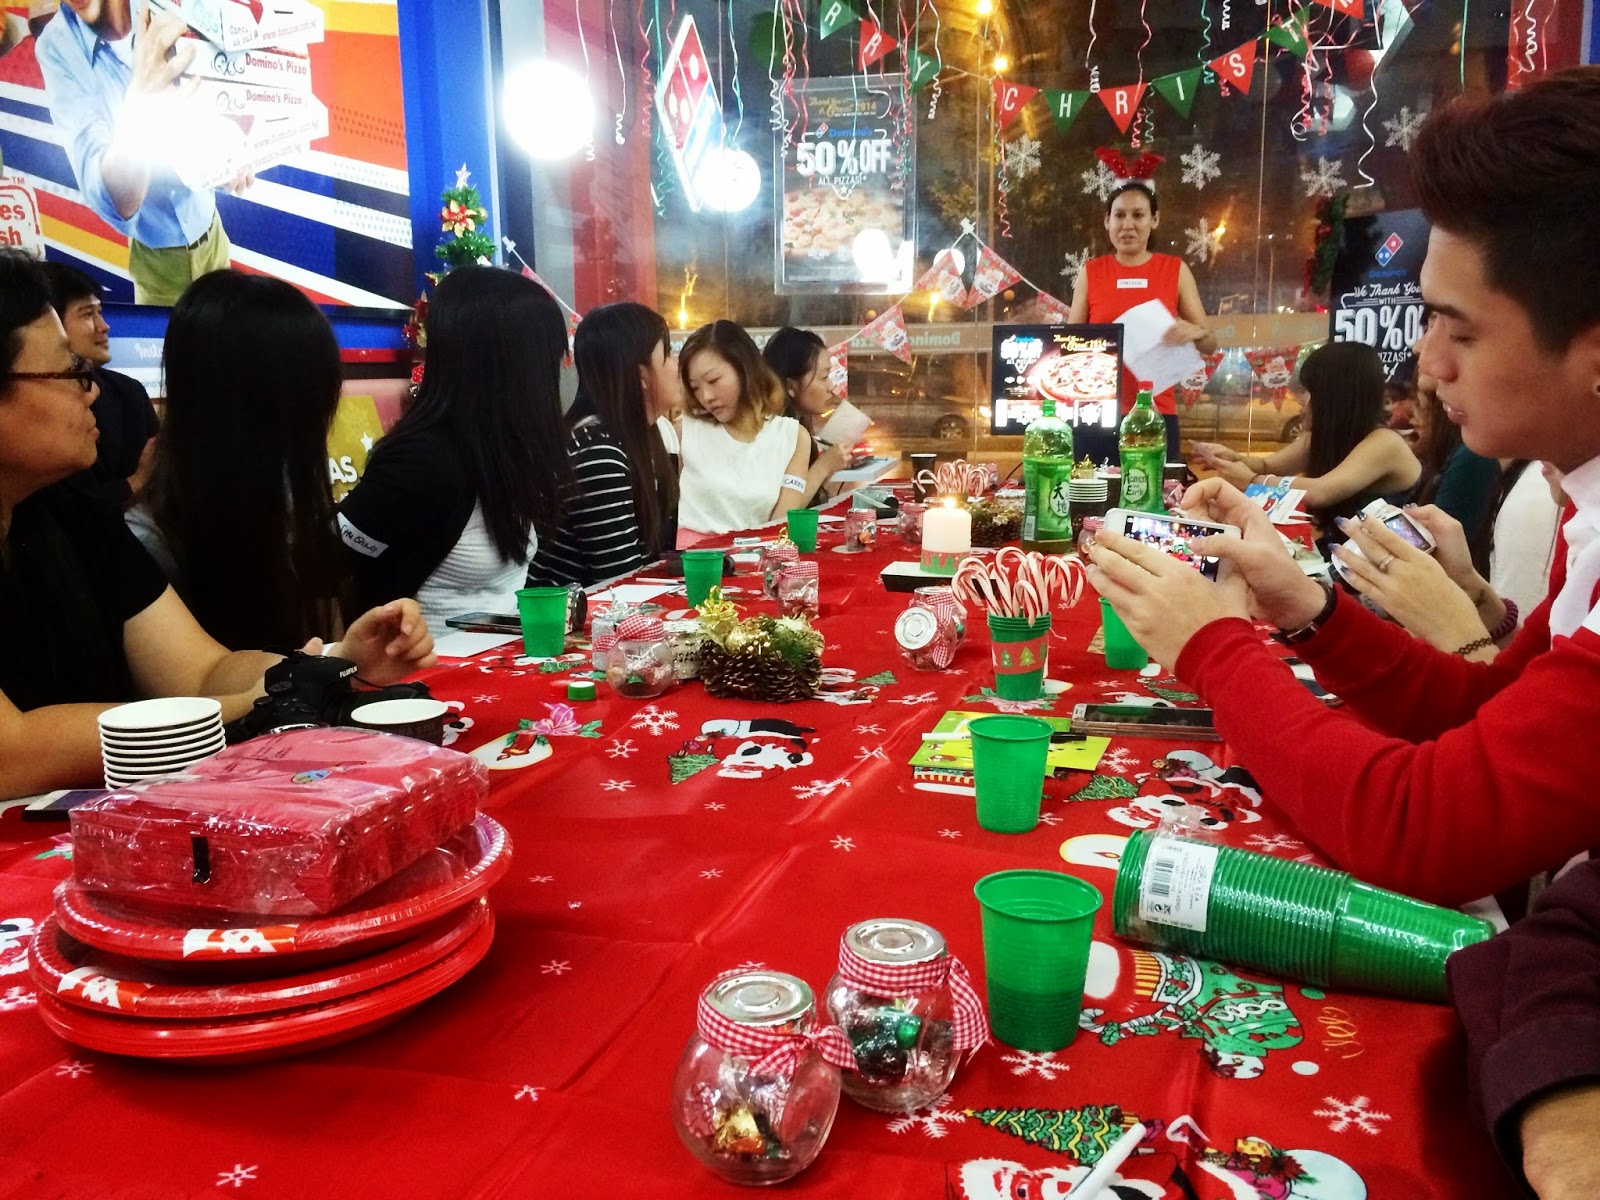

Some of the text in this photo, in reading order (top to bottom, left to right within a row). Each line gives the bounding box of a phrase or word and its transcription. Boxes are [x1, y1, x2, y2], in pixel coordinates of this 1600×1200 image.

[245, 52, 307, 75] Domino's Pizza
[246, 89, 302, 105] Domino's Pizza
[1353, 285, 1368, 298] We
[1369, 282, 1401, 297] Thank
[1378, 297, 1397, 305] WITH
